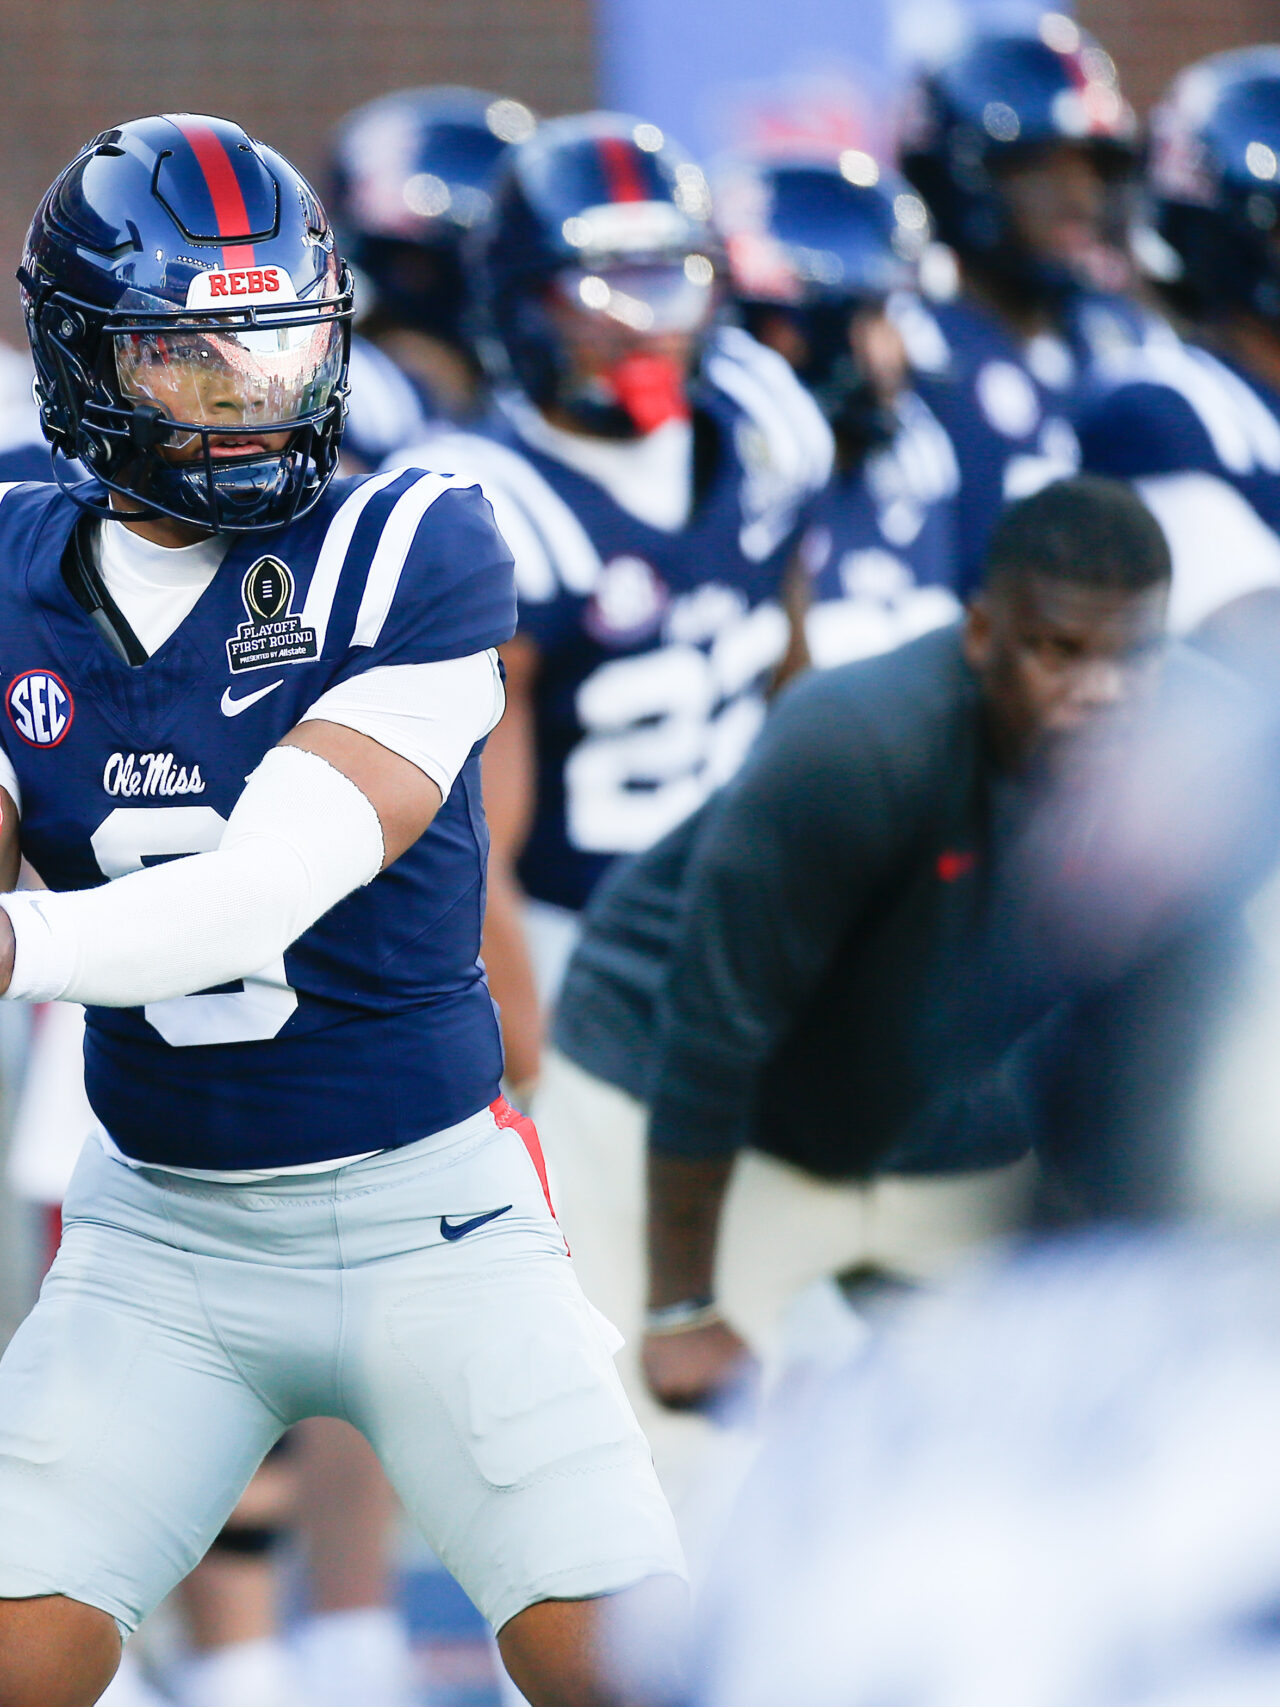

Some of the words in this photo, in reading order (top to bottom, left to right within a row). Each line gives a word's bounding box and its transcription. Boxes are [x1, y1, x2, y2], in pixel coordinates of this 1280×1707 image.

[209, 269, 280, 297] REBS
[243, 620, 297, 639] PLAYOFF
[231, 638, 267, 655] FIRST
[269, 631, 313, 648] ROUND
[240, 652, 270, 664] PRESENTED
[278, 646, 307, 658] Allstate
[10, 675, 68, 744] SEC
[103, 752, 141, 797] Ole
[140, 752, 206, 796] Miss
